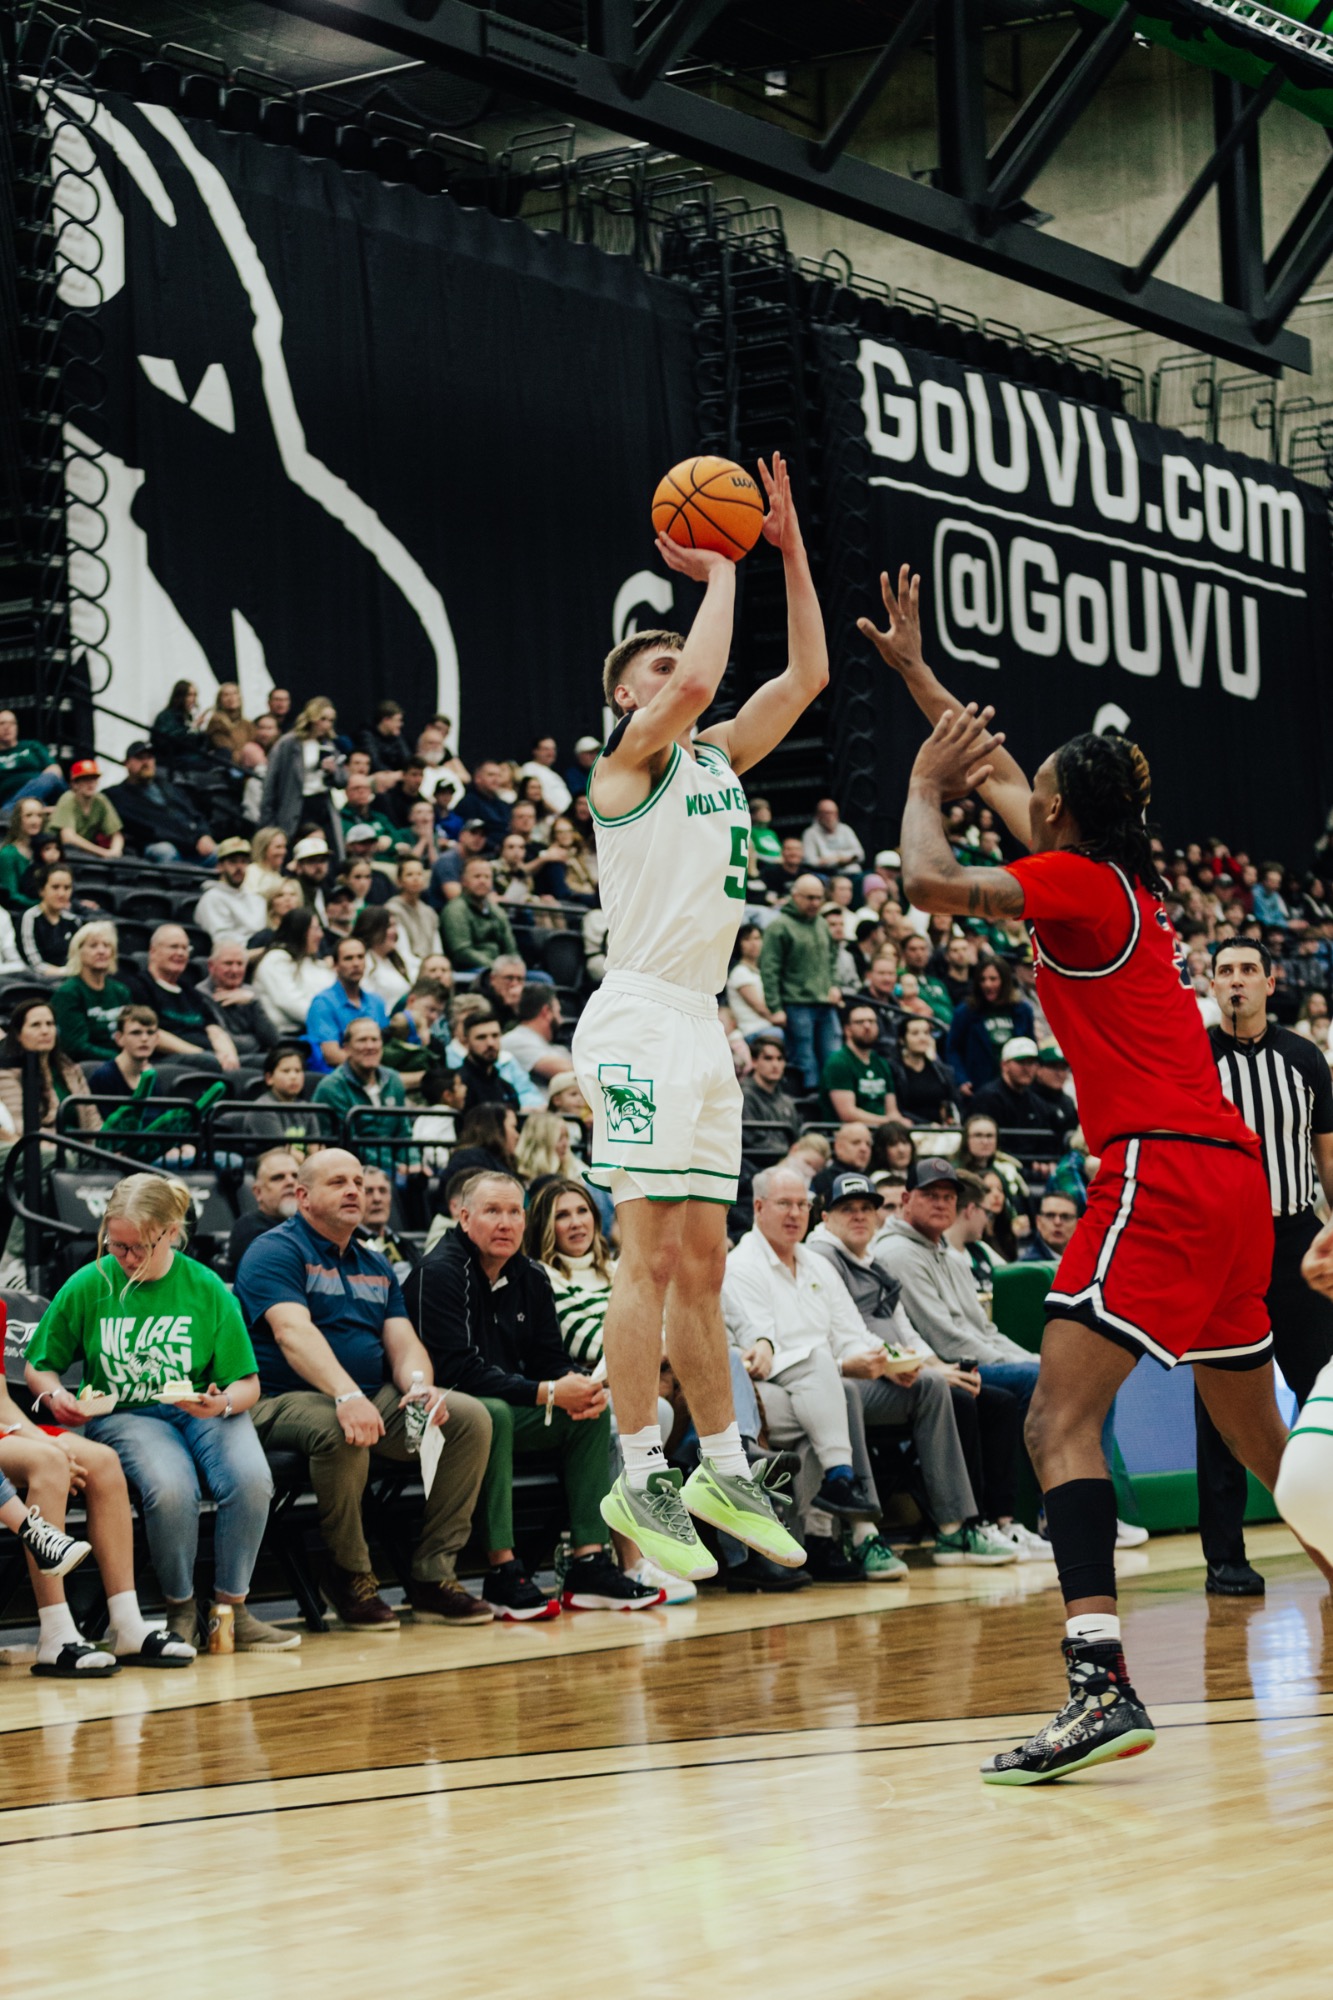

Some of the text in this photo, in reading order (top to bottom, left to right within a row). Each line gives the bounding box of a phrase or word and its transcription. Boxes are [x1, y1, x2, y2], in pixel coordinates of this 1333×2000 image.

[856, 338, 1306, 574] GoUVU.com
[933, 517, 1260, 700] @GoUVU
[724, 826, 749, 900] 5
[100, 1315, 192, 1362] WE ARE
